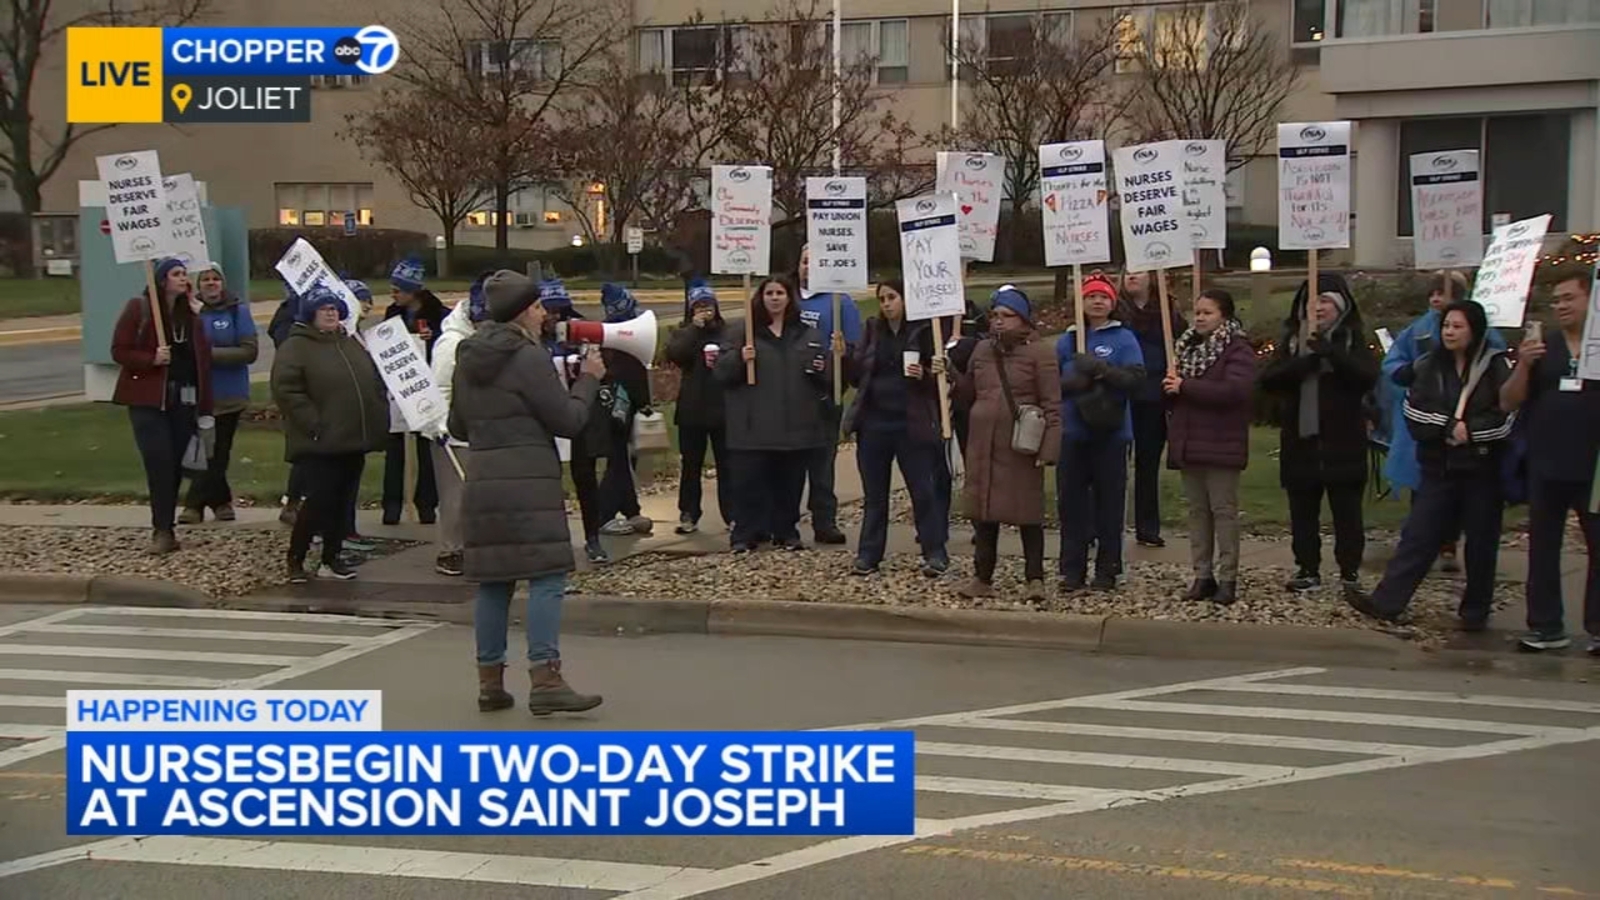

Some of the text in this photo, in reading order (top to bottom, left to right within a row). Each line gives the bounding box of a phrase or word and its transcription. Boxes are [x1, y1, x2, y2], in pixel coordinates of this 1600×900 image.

[108, 176, 152, 190] NURSES
[1124, 170, 1172, 187] NURSES
[109, 189, 157, 204] DESERVE
[1124, 186, 1178, 204] DESERVE
[122, 204, 149, 217] FAIR
[812, 212, 861, 221] PAY UNION
[1138, 204, 1167, 218] FAIR
[117, 217, 161, 232] WAGES
[1130, 219, 1179, 236] WAGES
[826, 244, 848, 252] SAVE
[905, 233, 932, 254] PAY
[832, 258, 857, 268] JOE'S
[913, 259, 952, 280] YOUR
[295, 259, 320, 287] NURSES
[379, 340, 410, 361] NURSES
[383, 352, 419, 375] DESERVE
[397, 367, 419, 382] FAIR
[399, 377, 431, 399] WAGES
